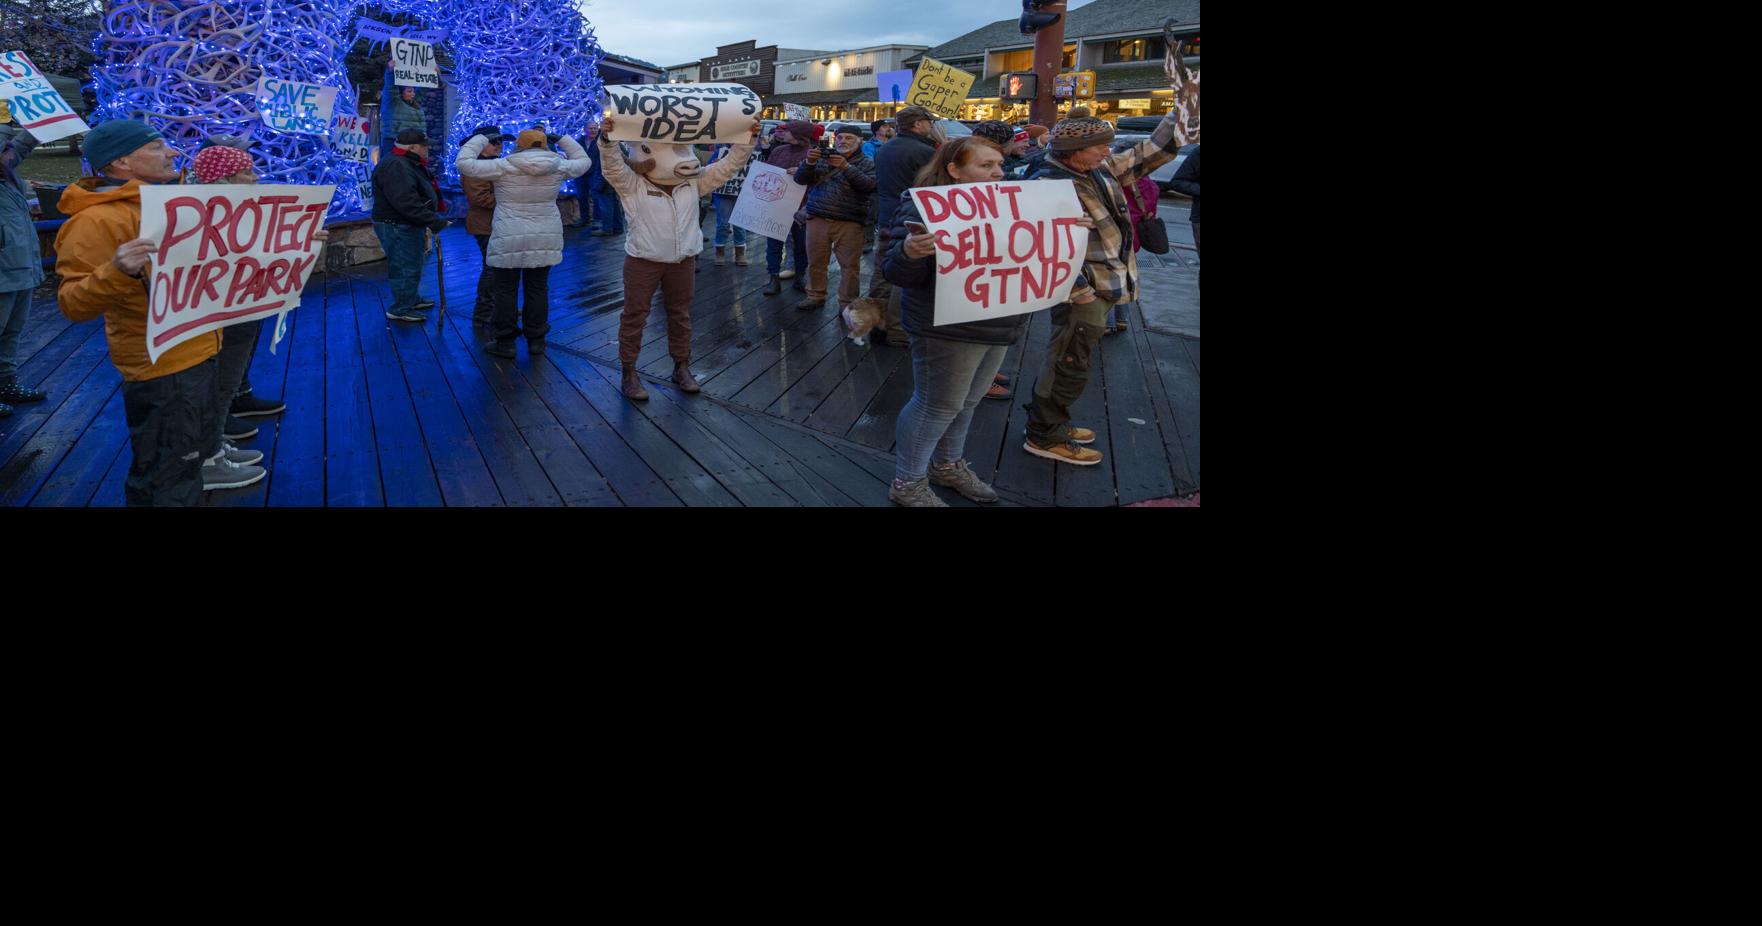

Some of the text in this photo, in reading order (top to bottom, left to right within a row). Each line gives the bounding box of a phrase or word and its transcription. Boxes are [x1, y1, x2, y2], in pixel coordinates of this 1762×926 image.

[396, 40, 434, 67] GTNP
[395, 69, 414, 80] REAL
[917, 74, 959, 100] Gaper
[944, 68, 955, 85] be
[264, 79, 320, 106] SAVE
[338, 115, 357, 129] WE
[611, 93, 728, 124] WORST
[641, 117, 717, 142] IDEA
[916, 184, 1022, 223] DON'T
[158, 196, 329, 267] PROTECT
[934, 218, 1078, 275] SELL OUT
[152, 254, 316, 325] OUR PARK
[964, 262, 1072, 309] GTNP
